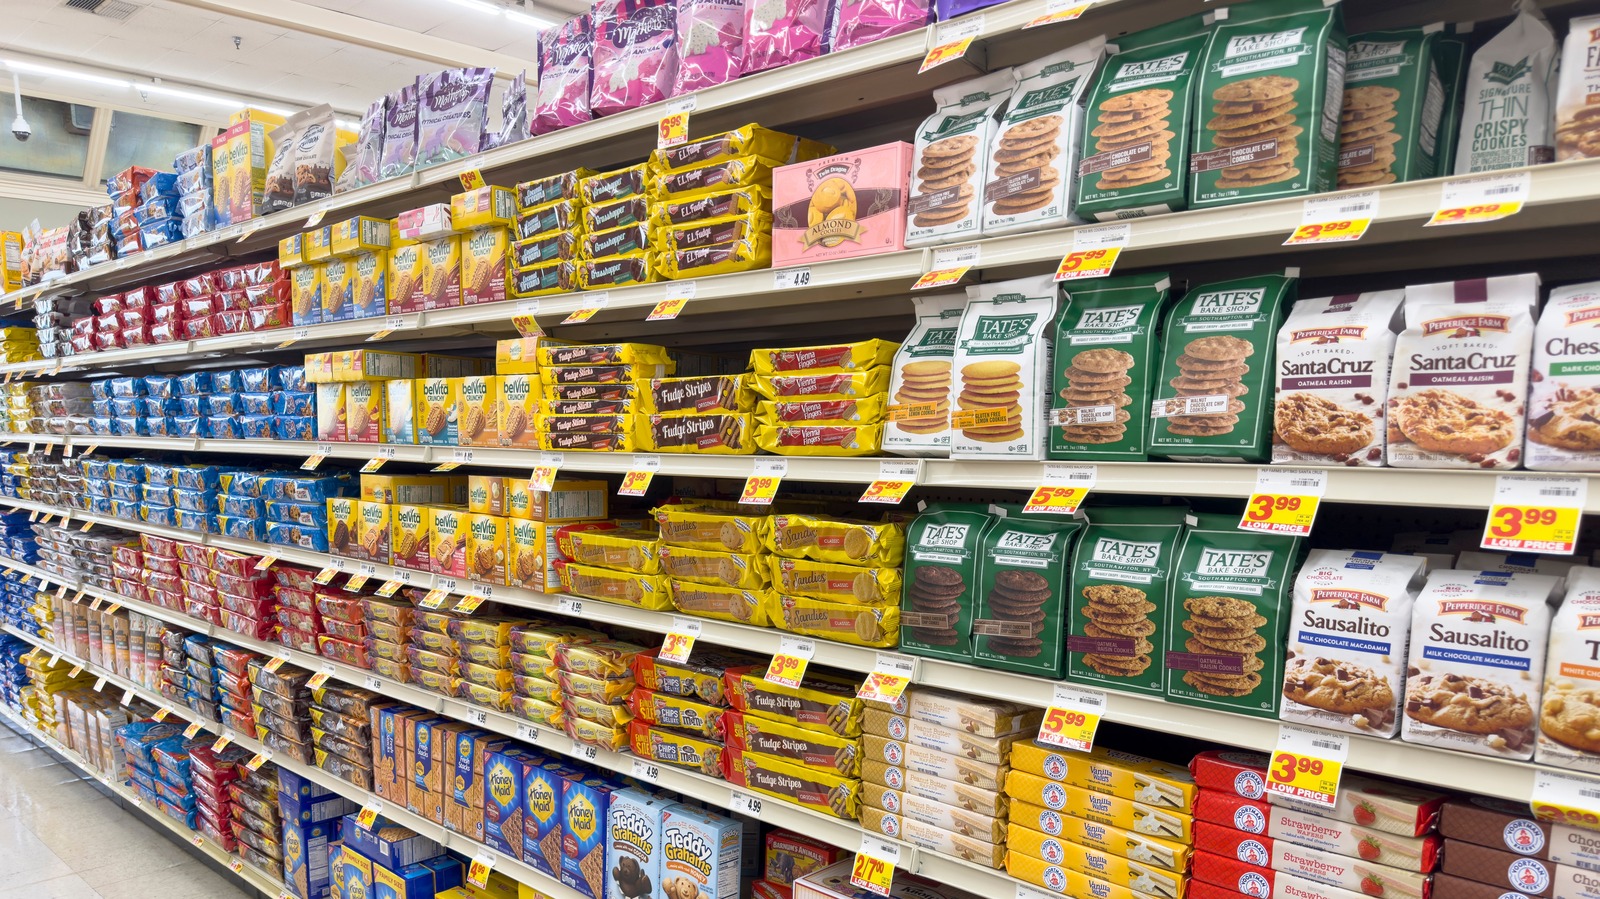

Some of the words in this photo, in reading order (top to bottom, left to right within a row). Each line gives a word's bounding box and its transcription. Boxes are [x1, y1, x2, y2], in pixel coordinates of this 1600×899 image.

[1232, 30, 1301, 47] TATE'S
[1235, 42, 1261, 54] BAKE
[1264, 38, 1290, 49] SHOP
[1124, 55, 1183, 72] TATE'S
[1479, 84, 1532, 99] SIGNATURE
[1479, 96, 1529, 121] THIN
[1474, 119, 1529, 139] CRISPY
[1232, 145, 1260, 157] CHOCOLATE
[1262, 142, 1275, 151] CHIP
[1472, 135, 1527, 152] COOKIES
[1112, 148, 1137, 160] CHOCOLATE
[1138, 146, 1149, 154] CHIP
[1232, 154, 1254, 164] COOKIES
[818, 157, 849, 166] PREMIUM
[1111, 157, 1131, 166] COOKIES
[830, 167, 848, 175] Dragon
[595, 206, 625, 226] Grasshopper
[812, 220, 852, 235] ALMOND
[820, 228, 842, 236] COOKIES
[469, 235, 496, 249] belVita
[595, 233, 625, 252] Grasshopper
[473, 247, 491, 256] CRUNCHY
[794, 272, 810, 286] 4.49
[1198, 291, 1261, 307] TATE'S
[1084, 308, 1140, 323] TATE'S
[981, 318, 1031, 334] TATE'S
[1428, 319, 1477, 331] PEPPERIDGE
[1479, 318, 1501, 328] FARM
[1003, 329, 1021, 339] SHOP
[1295, 328, 1339, 340] PEPPERIDGE
[1340, 328, 1359, 337] FARM
[796, 351, 815, 362] Vienna
[1300, 349, 1319, 357] SOFT
[1323, 348, 1351, 356] BAKED
[798, 359, 817, 369] Fingers
[423, 381, 448, 395] belVita
[503, 379, 530, 393] belVita
[1297, 379, 1328, 387] OATMEAL
[661, 388, 685, 403] Fudge
[685, 382, 712, 398] Stripes
[698, 400, 718, 409] ORIGINAL
[558, 437, 572, 447] Fudge
[573, 434, 587, 444] Sticks
[434, 516, 458, 529] belVita
[471, 520, 497, 535] belVita
[667, 521, 697, 535] Sandies
[437, 526, 455, 535] SANDWICH
[926, 525, 966, 540] TATE'S
[483, 534, 495, 542] BAKED
[1005, 532, 1054, 545] TATE'S
[1490, 538, 1522, 549] LOW
[1524, 540, 1565, 550] PRICE
[1100, 540, 1157, 559] TATE'S
[1205, 551, 1267, 568] TATE'S
[1316, 590, 1358, 601] PEPPERIDGE
[1359, 593, 1381, 606] FARM
[570, 602, 582, 614] 4.99
[1444, 601, 1494, 613] PEPPERIDGE
[1495, 604, 1520, 618] FARM
[794, 611, 828, 625] Sandies
[1303, 610, 1389, 637] Sausalito
[1314, 637, 1349, 647] CHOCOLATE
[1350, 642, 1388, 652] MACADAMIA
[1429, 623, 1529, 652] Sausalito
[1426, 650, 1440, 658] MILK
[1441, 652, 1483, 663] CHOCOLATE
[1484, 657, 1528, 668] MACADAMIA
[1216, 664, 1240, 672] COOKIES
[1563, 667, 1584, 675] WHITE
[767, 674, 779, 682] LOW
[780, 677, 797, 687] PRICE
[755, 695, 776, 708] Fudge
[776, 697, 801, 709] Stripes
[661, 708, 679, 718] CHIPS
[661, 716, 679, 725] DELUXE
[460, 755, 471, 764] Fresh
[585, 746, 596, 759] 4.99
[458, 762, 471, 772] Stacks
[1044, 755, 1065, 768] VOORTMAN
[1090, 765, 1113, 778] Vanilla
[1092, 773, 1110, 783] Wafers
[1271, 783, 1296, 793] LOW
[1297, 785, 1329, 802] PRICE
[569, 803, 593, 820] Honey
[747, 798, 761, 812] 4.99
[573, 815, 592, 831] Maid
[612, 810, 652, 838] Teddy
[1280, 817, 1342, 840] Strawberry
[1507, 821, 1540, 836] VOORTMAN
[906, 822, 926, 834] Peanut
[927, 827, 944, 839] Butter
[1296, 829, 1324, 840] WAFERS
[612, 824, 652, 855] Grahams
[666, 828, 712, 861] Teddy
[773, 842, 798, 854] BARNUM'S
[798, 846, 823, 861] ANIMALS
[1513, 843, 1535, 851] BAKERY
[632, 849, 647, 862] COCOA
[664, 841, 711, 876] Grahams
[360, 860, 369, 870] SIZE
[690, 869, 707, 883] HONEY
